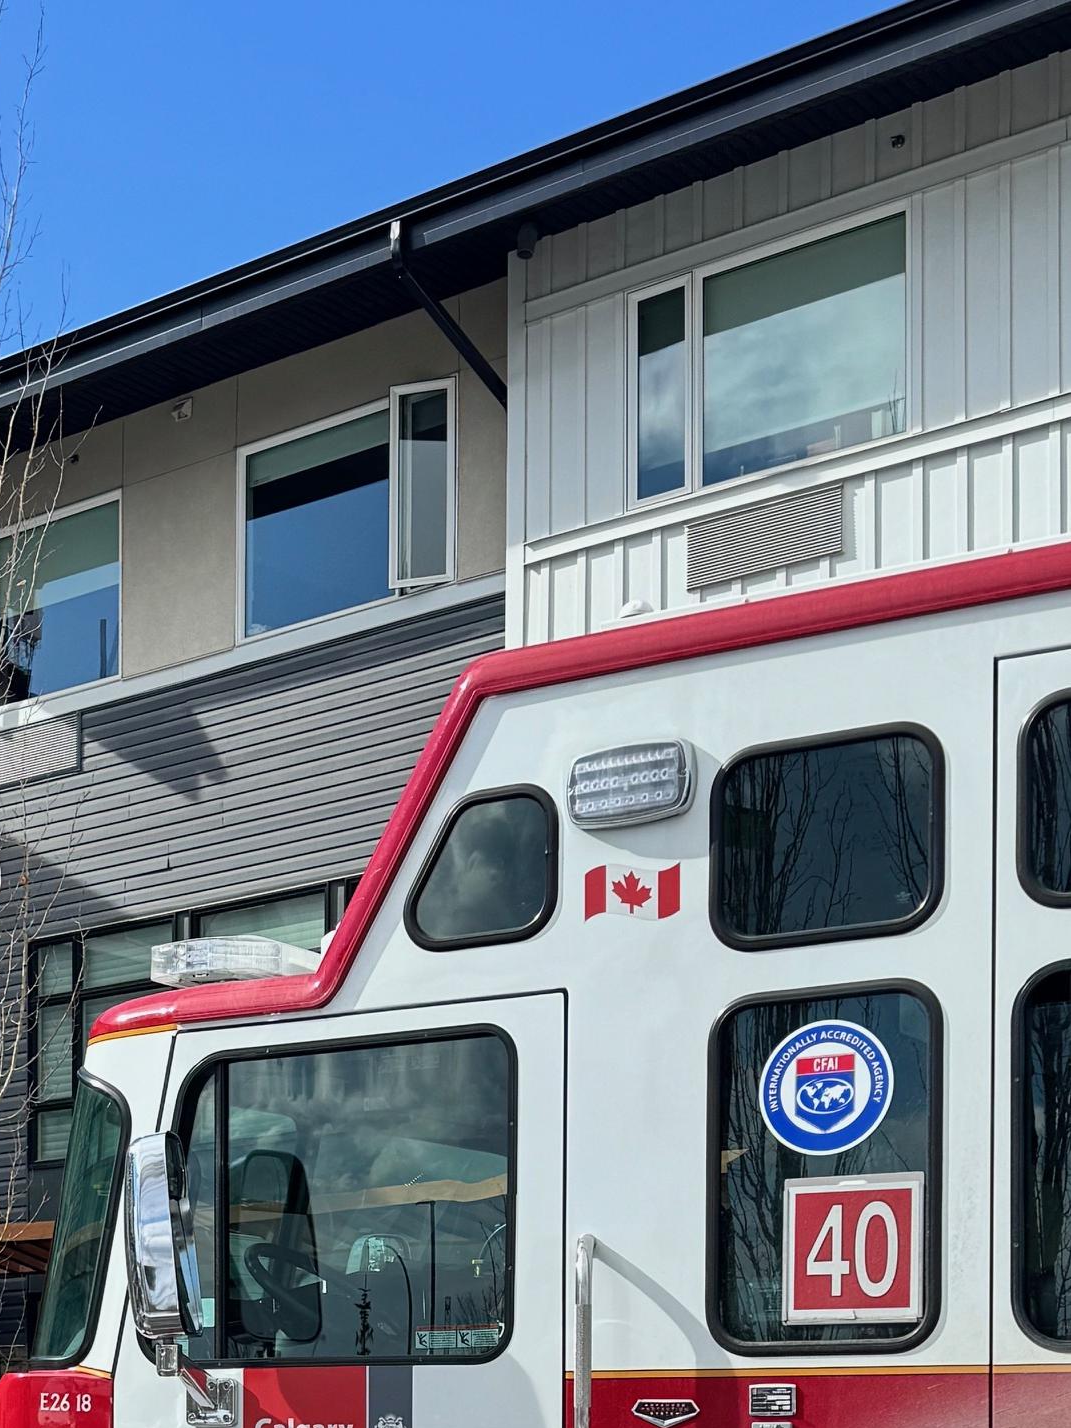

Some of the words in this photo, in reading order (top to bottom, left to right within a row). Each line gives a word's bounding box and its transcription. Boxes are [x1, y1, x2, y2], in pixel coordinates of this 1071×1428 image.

[767, 1032, 818, 1113] INTERNATIONALLY
[819, 1030, 876, 1064] ACCREDITED
[871, 1061, 884, 1104] AGENCY
[813, 1056, 839, 1072] CFAI
[806, 1200, 899, 1298] 40
[40, 1392, 71, 1412] E26
[76, 1393, 92, 1413] 18
